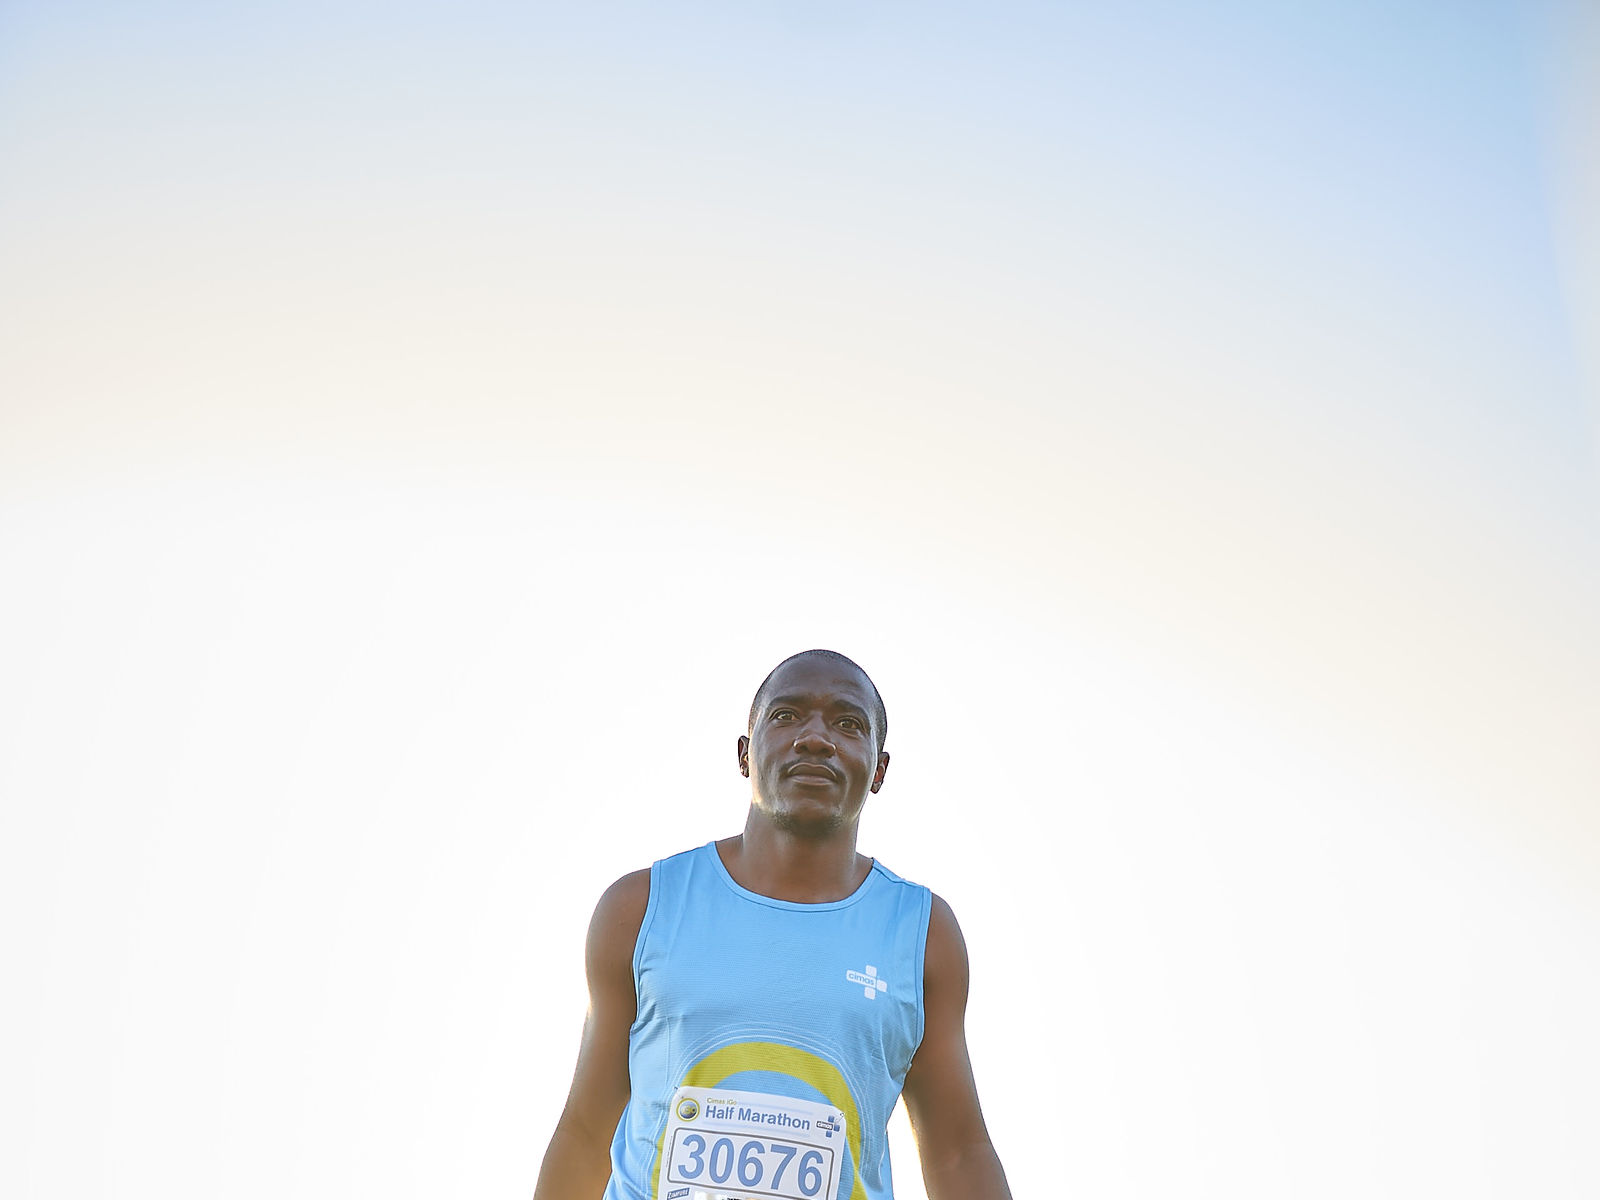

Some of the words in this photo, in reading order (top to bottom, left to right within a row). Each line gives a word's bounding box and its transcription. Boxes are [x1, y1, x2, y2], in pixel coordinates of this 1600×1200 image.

[848, 972, 875, 986] cimas
[705, 1105, 735, 1119] Half
[738, 1107, 811, 1130] Marathon
[678, 1134, 824, 1197] 30676
